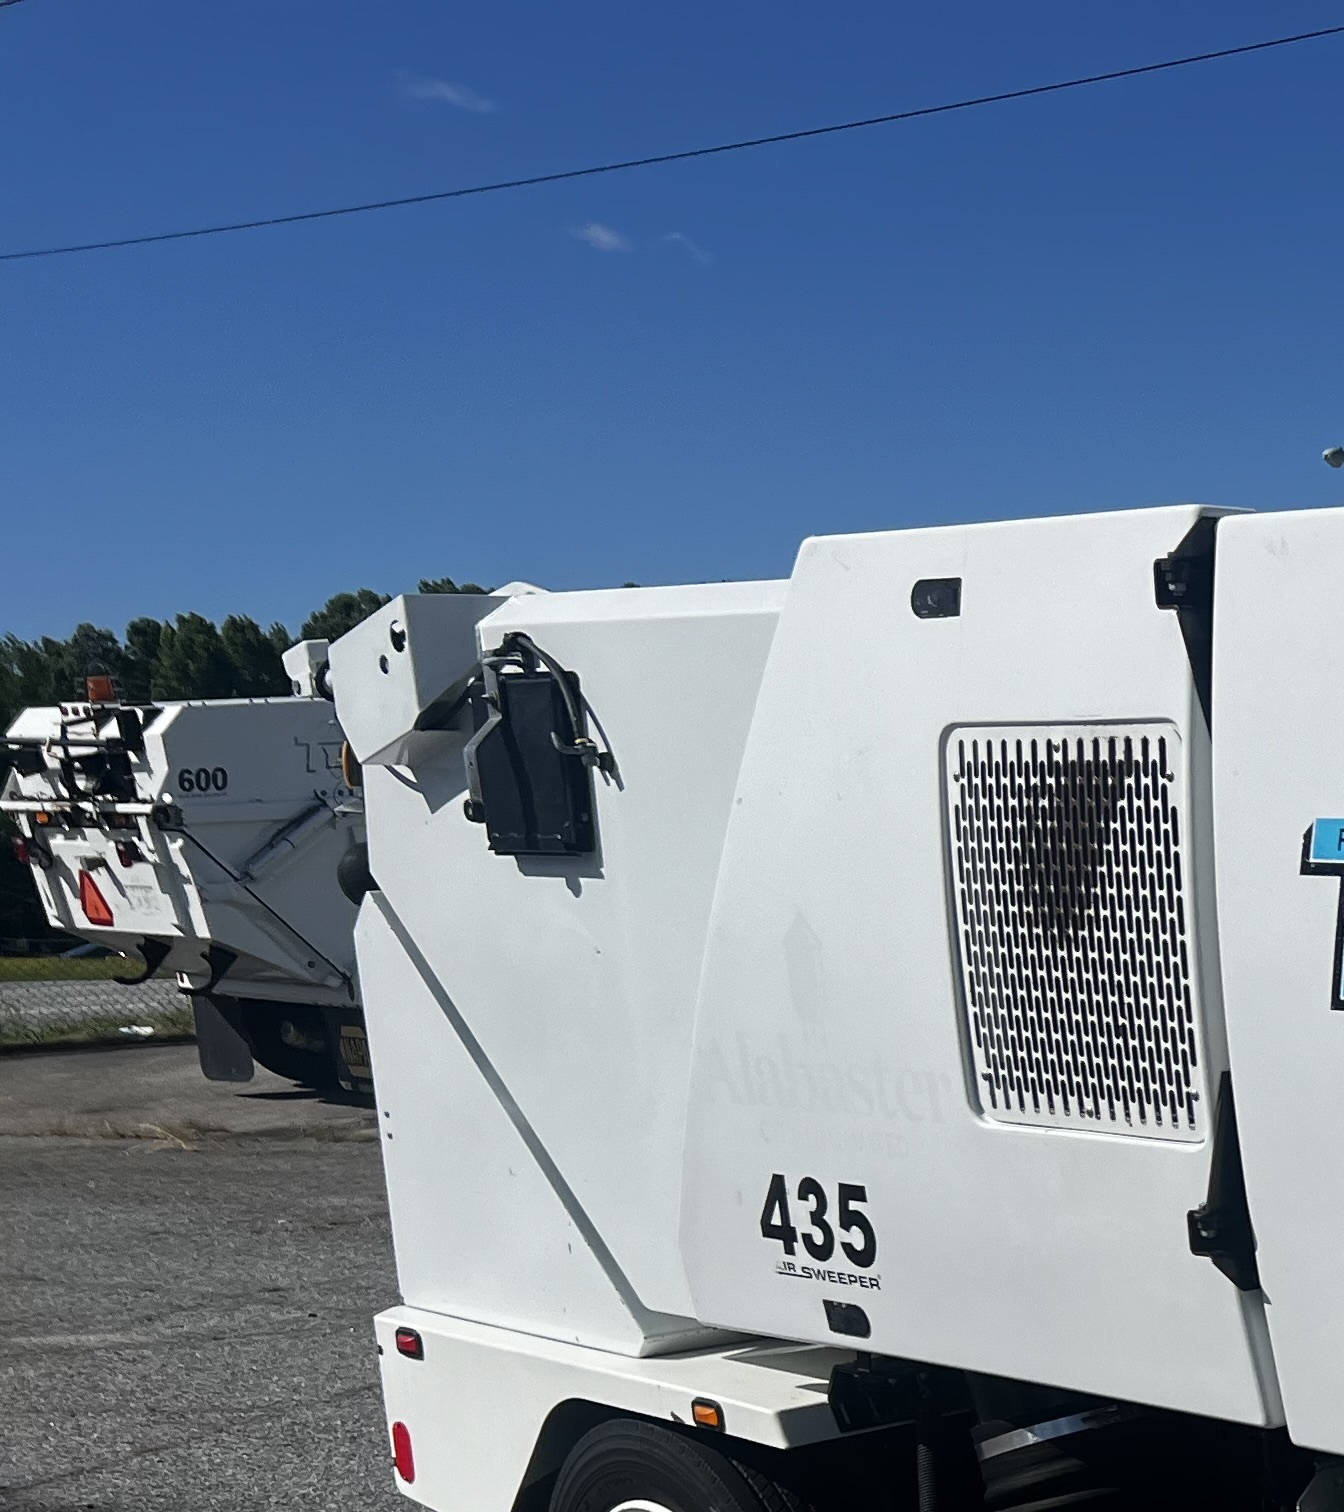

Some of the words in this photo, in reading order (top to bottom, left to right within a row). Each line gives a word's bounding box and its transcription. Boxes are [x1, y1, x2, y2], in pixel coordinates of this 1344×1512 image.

[178, 767, 228, 792] 600
[760, 1173, 877, 1268] 435
[801, 1266, 881, 1290] SWEEPER
